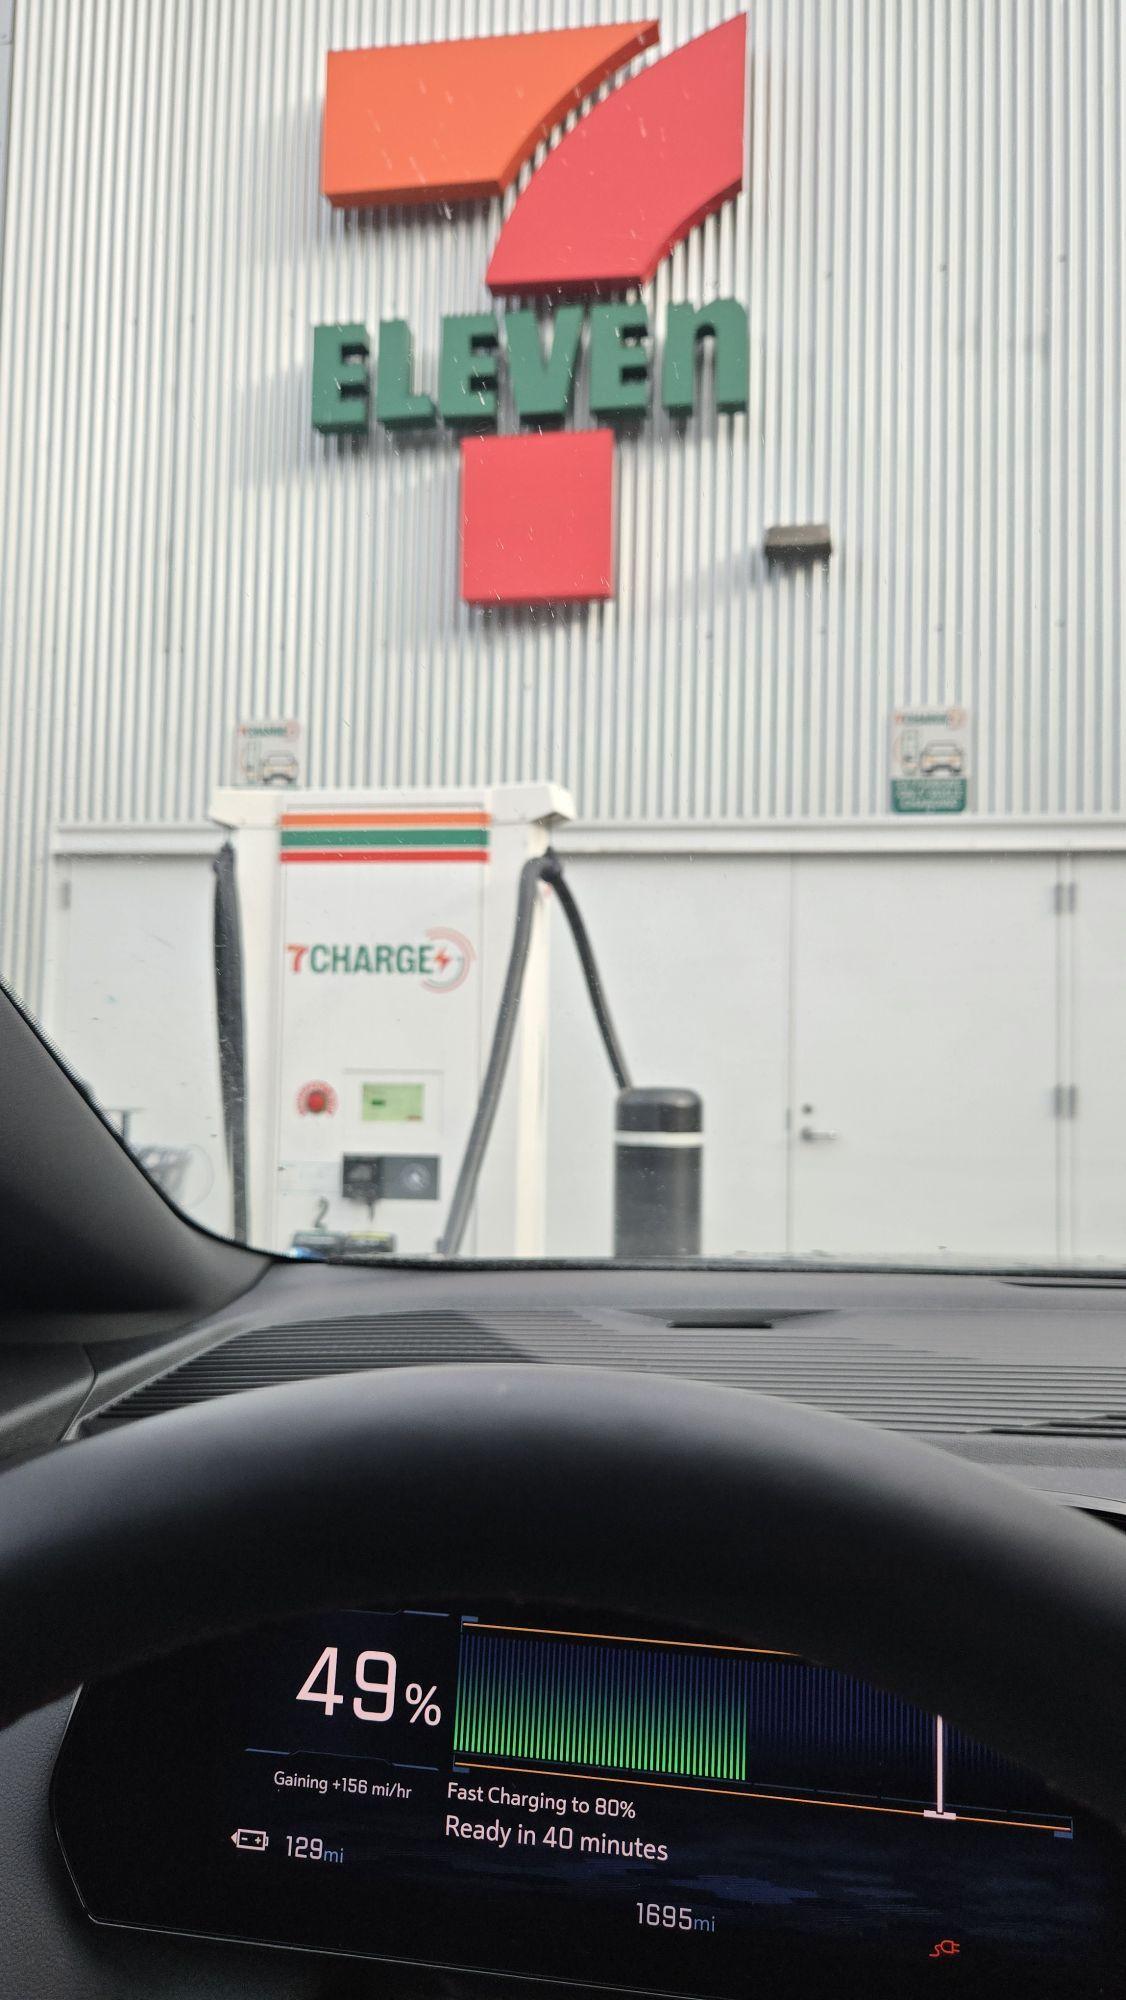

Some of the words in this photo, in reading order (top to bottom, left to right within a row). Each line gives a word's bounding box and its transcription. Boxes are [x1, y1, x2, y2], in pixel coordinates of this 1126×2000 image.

[286, 943, 434, 974] 7CHARGE
[295, 1646, 442, 1727] 49%
[273, 1770, 328, 1794] Gaining
[332, 1777, 368, 1795] +156
[371, 1782, 413, 1799] mi/hr
[447, 1781, 484, 1803] Fast
[487, 1786, 567, 1816] Charging
[571, 1796, 590, 1814] to
[594, 1797, 636, 1819] 80%
[445, 1814, 512, 1849] Ready
[517, 1824, 536, 1846] in
[542, 1826, 574, 1850] 40
[580, 1833, 669, 1862] minutes
